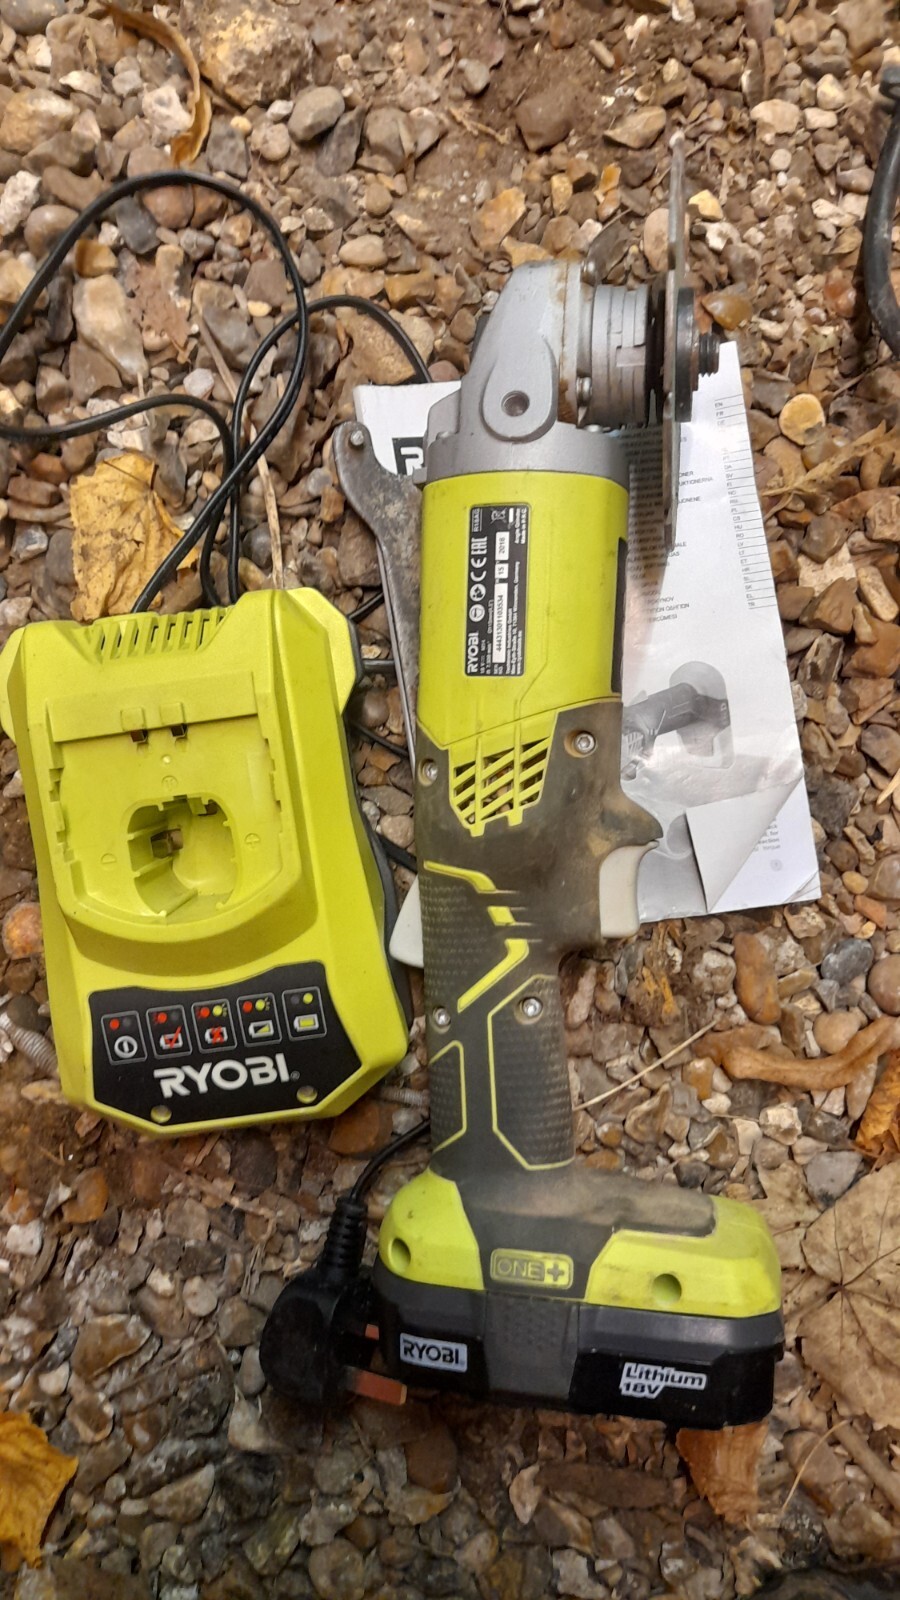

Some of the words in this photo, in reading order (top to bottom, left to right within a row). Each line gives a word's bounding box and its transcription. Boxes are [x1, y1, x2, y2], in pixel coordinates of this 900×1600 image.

[497, 566, 505, 575] 15
[467, 632, 479, 674] RYOBI
[153, 1053, 290, 1098] RYOBI
[402, 1338, 461, 1365] RYOBI
[625, 1363, 705, 1387] Lithium
[622, 1381, 662, 1397] 18V
